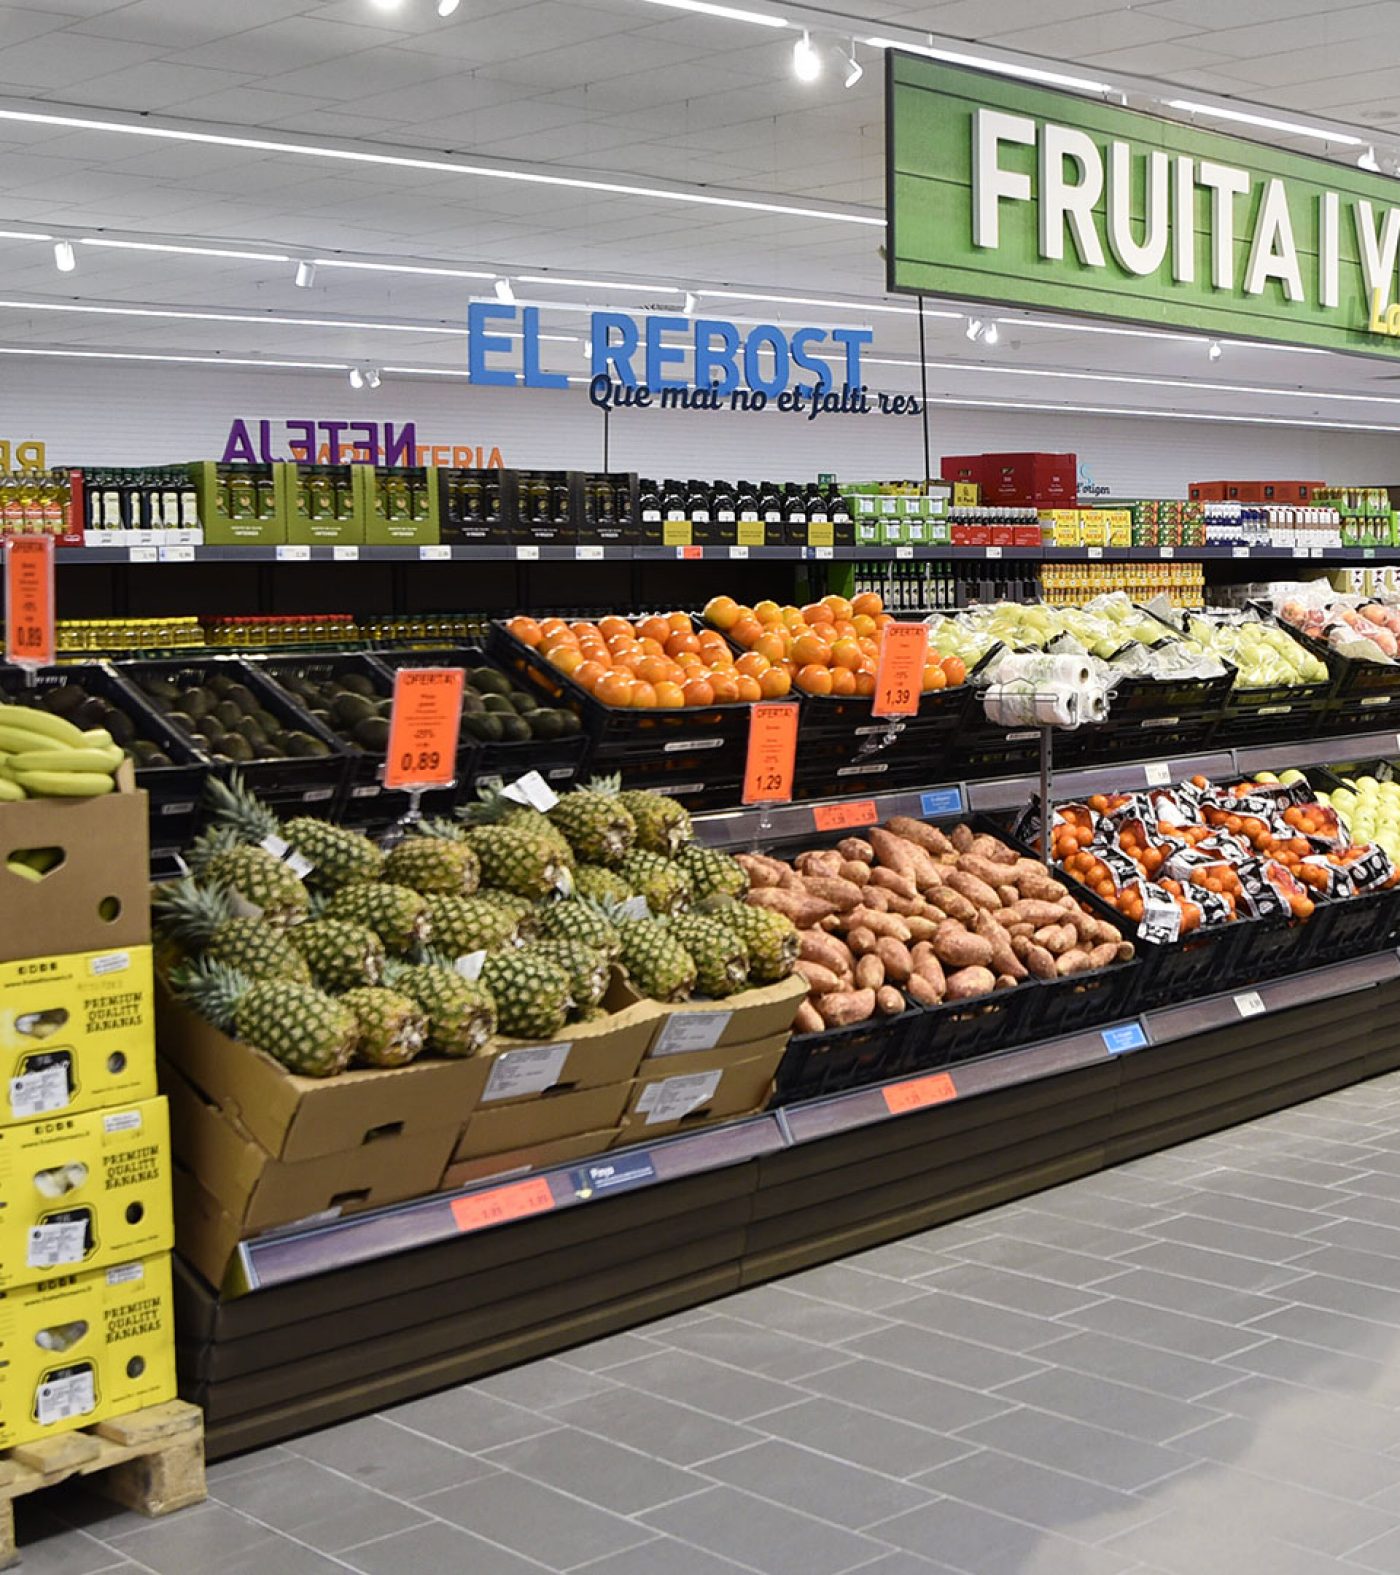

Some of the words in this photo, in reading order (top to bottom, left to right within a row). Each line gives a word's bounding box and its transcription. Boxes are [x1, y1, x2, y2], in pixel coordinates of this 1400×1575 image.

[972, 108, 1304, 302] FRUITA
[1319, 191, 1339, 308] I
[468, 303, 570, 389] EL
[591, 312, 873, 400] REBOST
[589, 373, 653, 412] Que
[661, 380, 723, 410] mai
[731, 389, 769, 412] no
[777, 383, 806, 413] et
[808, 381, 872, 420] falti
[877, 391, 923, 415] res
[401, 751, 440, 774] 0,89
[83, 992, 143, 1010] PREMIUM
[85, 1015, 143, 1034] BANANAS
[88, 1004, 140, 1022] QUALITY
[102, 1145, 160, 1167] PREMIUM
[105, 1168, 160, 1190] BANANAS
[107, 1158, 157, 1178] QUALITY
[103, 1297, 162, 1320] PREMIUM
[108, 1308, 160, 1332] QUALITY
[105, 1320, 162, 1345] BANANAS
